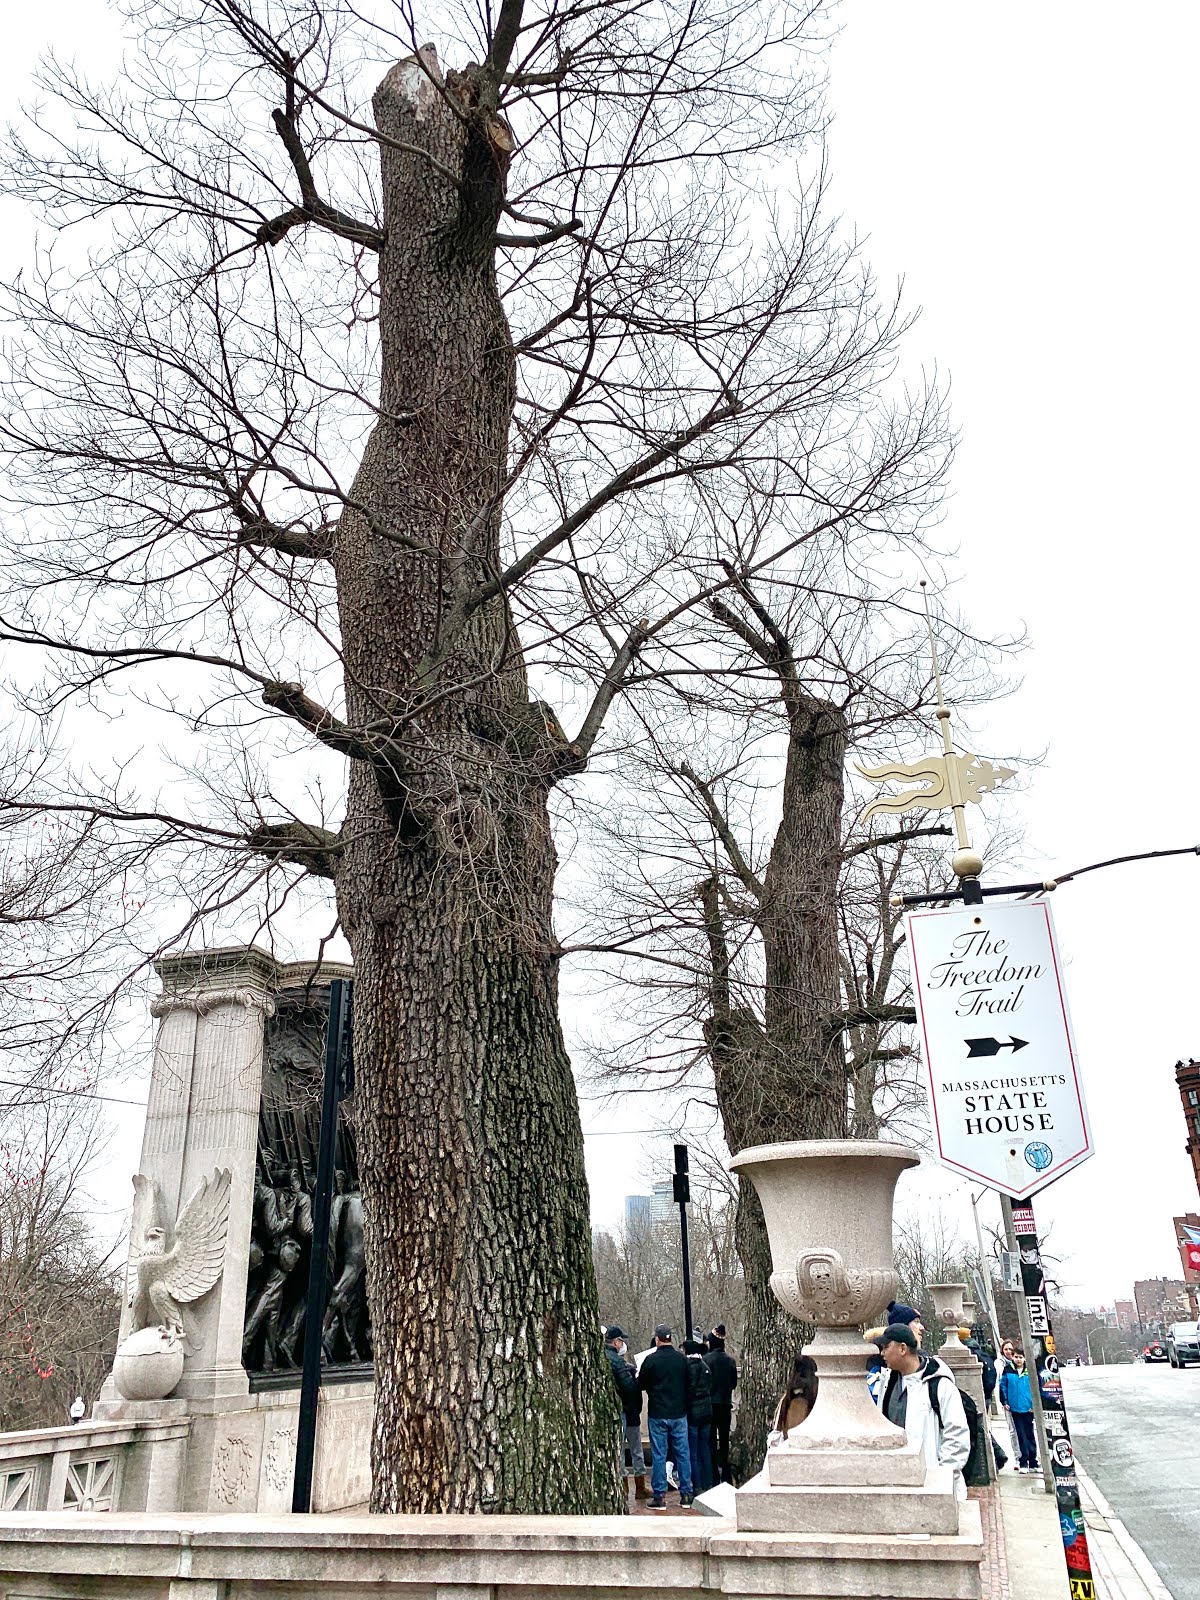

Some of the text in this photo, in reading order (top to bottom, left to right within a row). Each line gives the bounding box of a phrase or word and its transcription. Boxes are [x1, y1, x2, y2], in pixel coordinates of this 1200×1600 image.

[950, 930, 1008, 958] The
[927, 955, 1047, 989] Freedom
[955, 985, 1023, 1017] Trail
[942, 1075, 1066, 1092] MASSACHUSETTS
[965, 1092, 1047, 1112] STATE
[965, 1113, 1054, 1135] HOUSE
